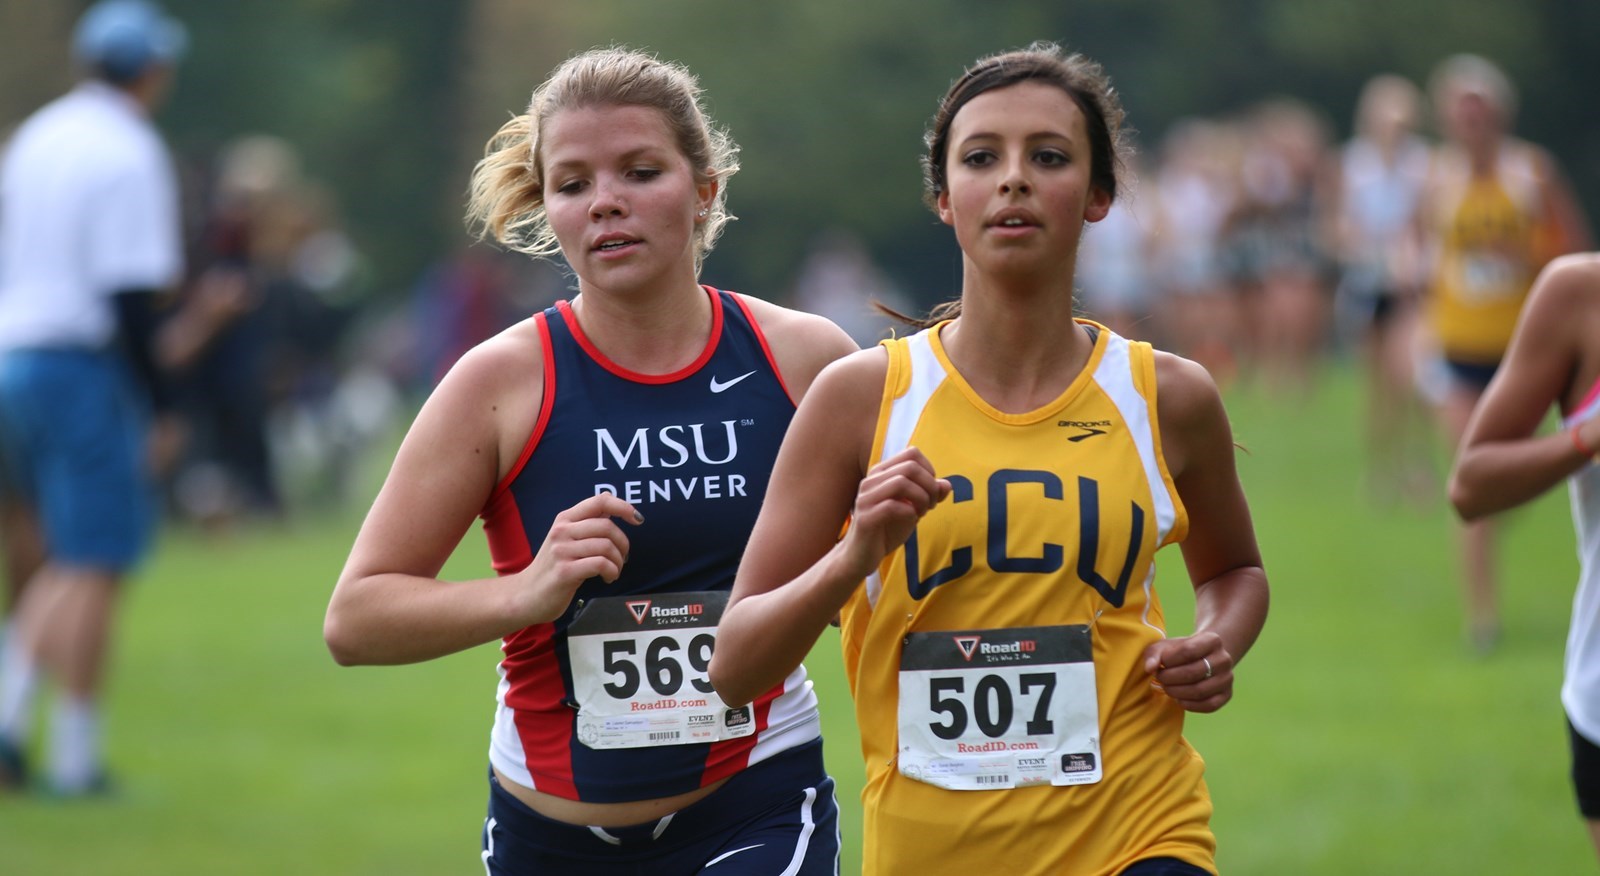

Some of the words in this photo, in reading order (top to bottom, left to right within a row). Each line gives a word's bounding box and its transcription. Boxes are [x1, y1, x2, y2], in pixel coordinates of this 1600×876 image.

[593, 420, 738, 471] MSU
[905, 468, 1144, 608] CCU
[603, 633, 717, 699] 569
[630, 699, 707, 712] RoadID.com
[929, 672, 1057, 740] 507
[957, 741, 1039, 753] RoadID.com
